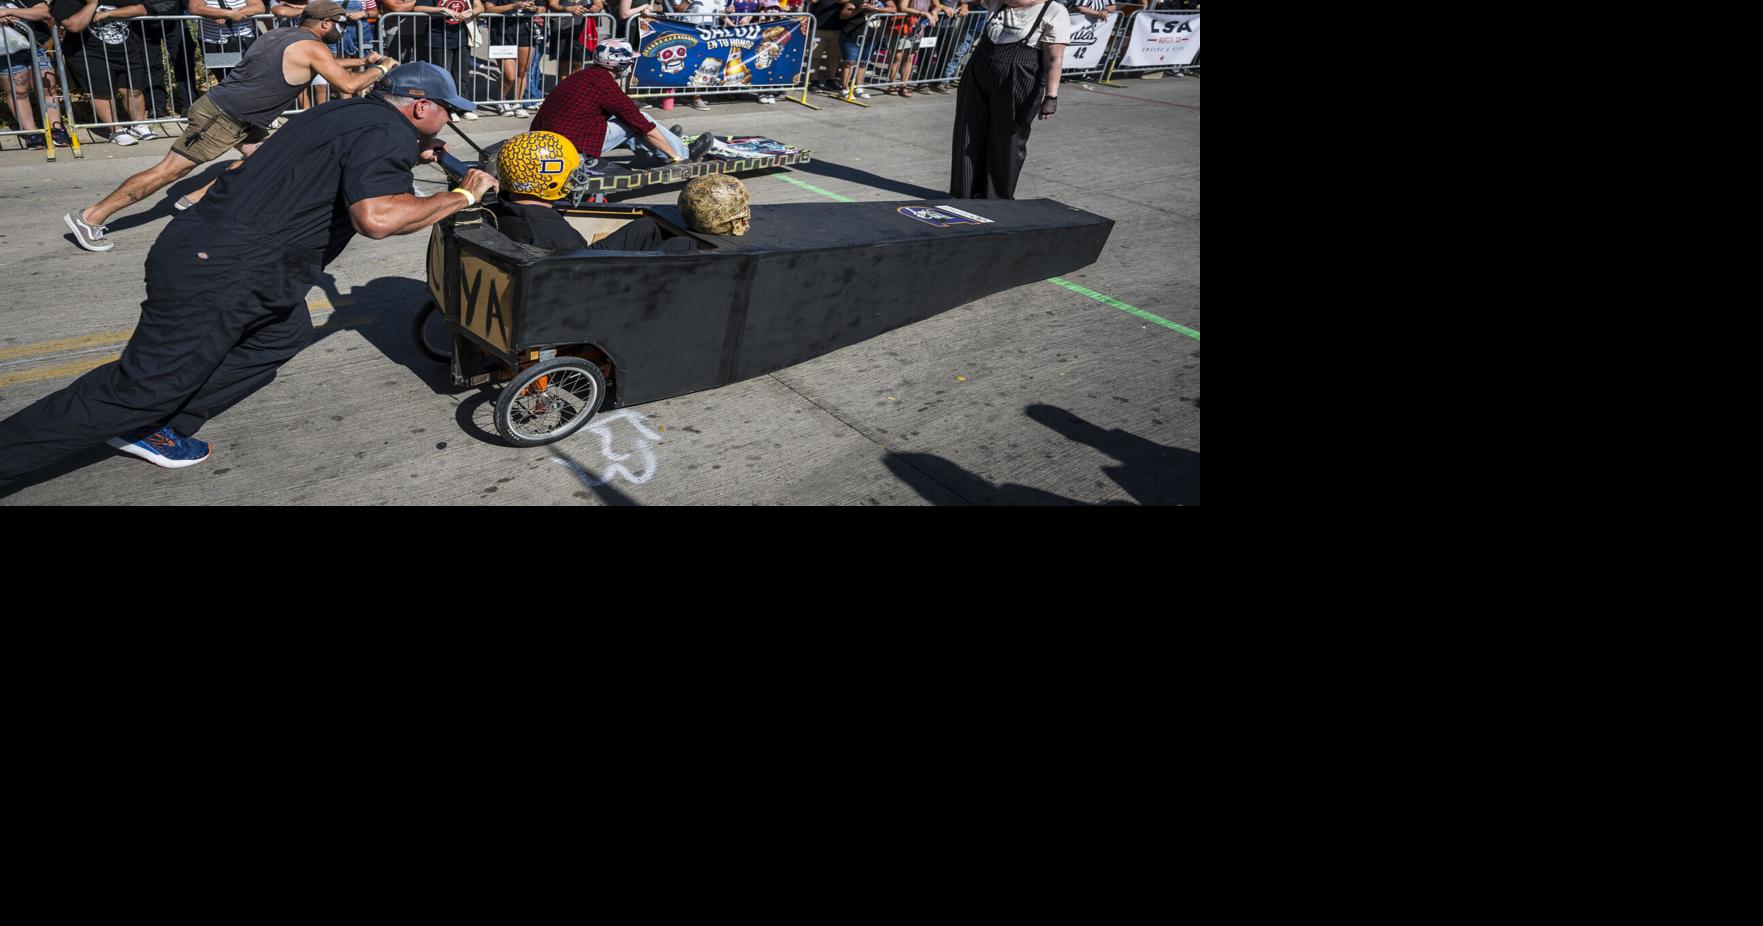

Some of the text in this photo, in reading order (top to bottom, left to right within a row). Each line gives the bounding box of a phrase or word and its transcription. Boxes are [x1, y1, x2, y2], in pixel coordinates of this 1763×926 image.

[1151, 19, 1192, 33] LSA
[707, 40, 718, 50] EN
[717, 38, 729, 47] TU
[1073, 47, 1087, 59] 42
[539, 159, 564, 174] D
[461, 265, 508, 351] YA
